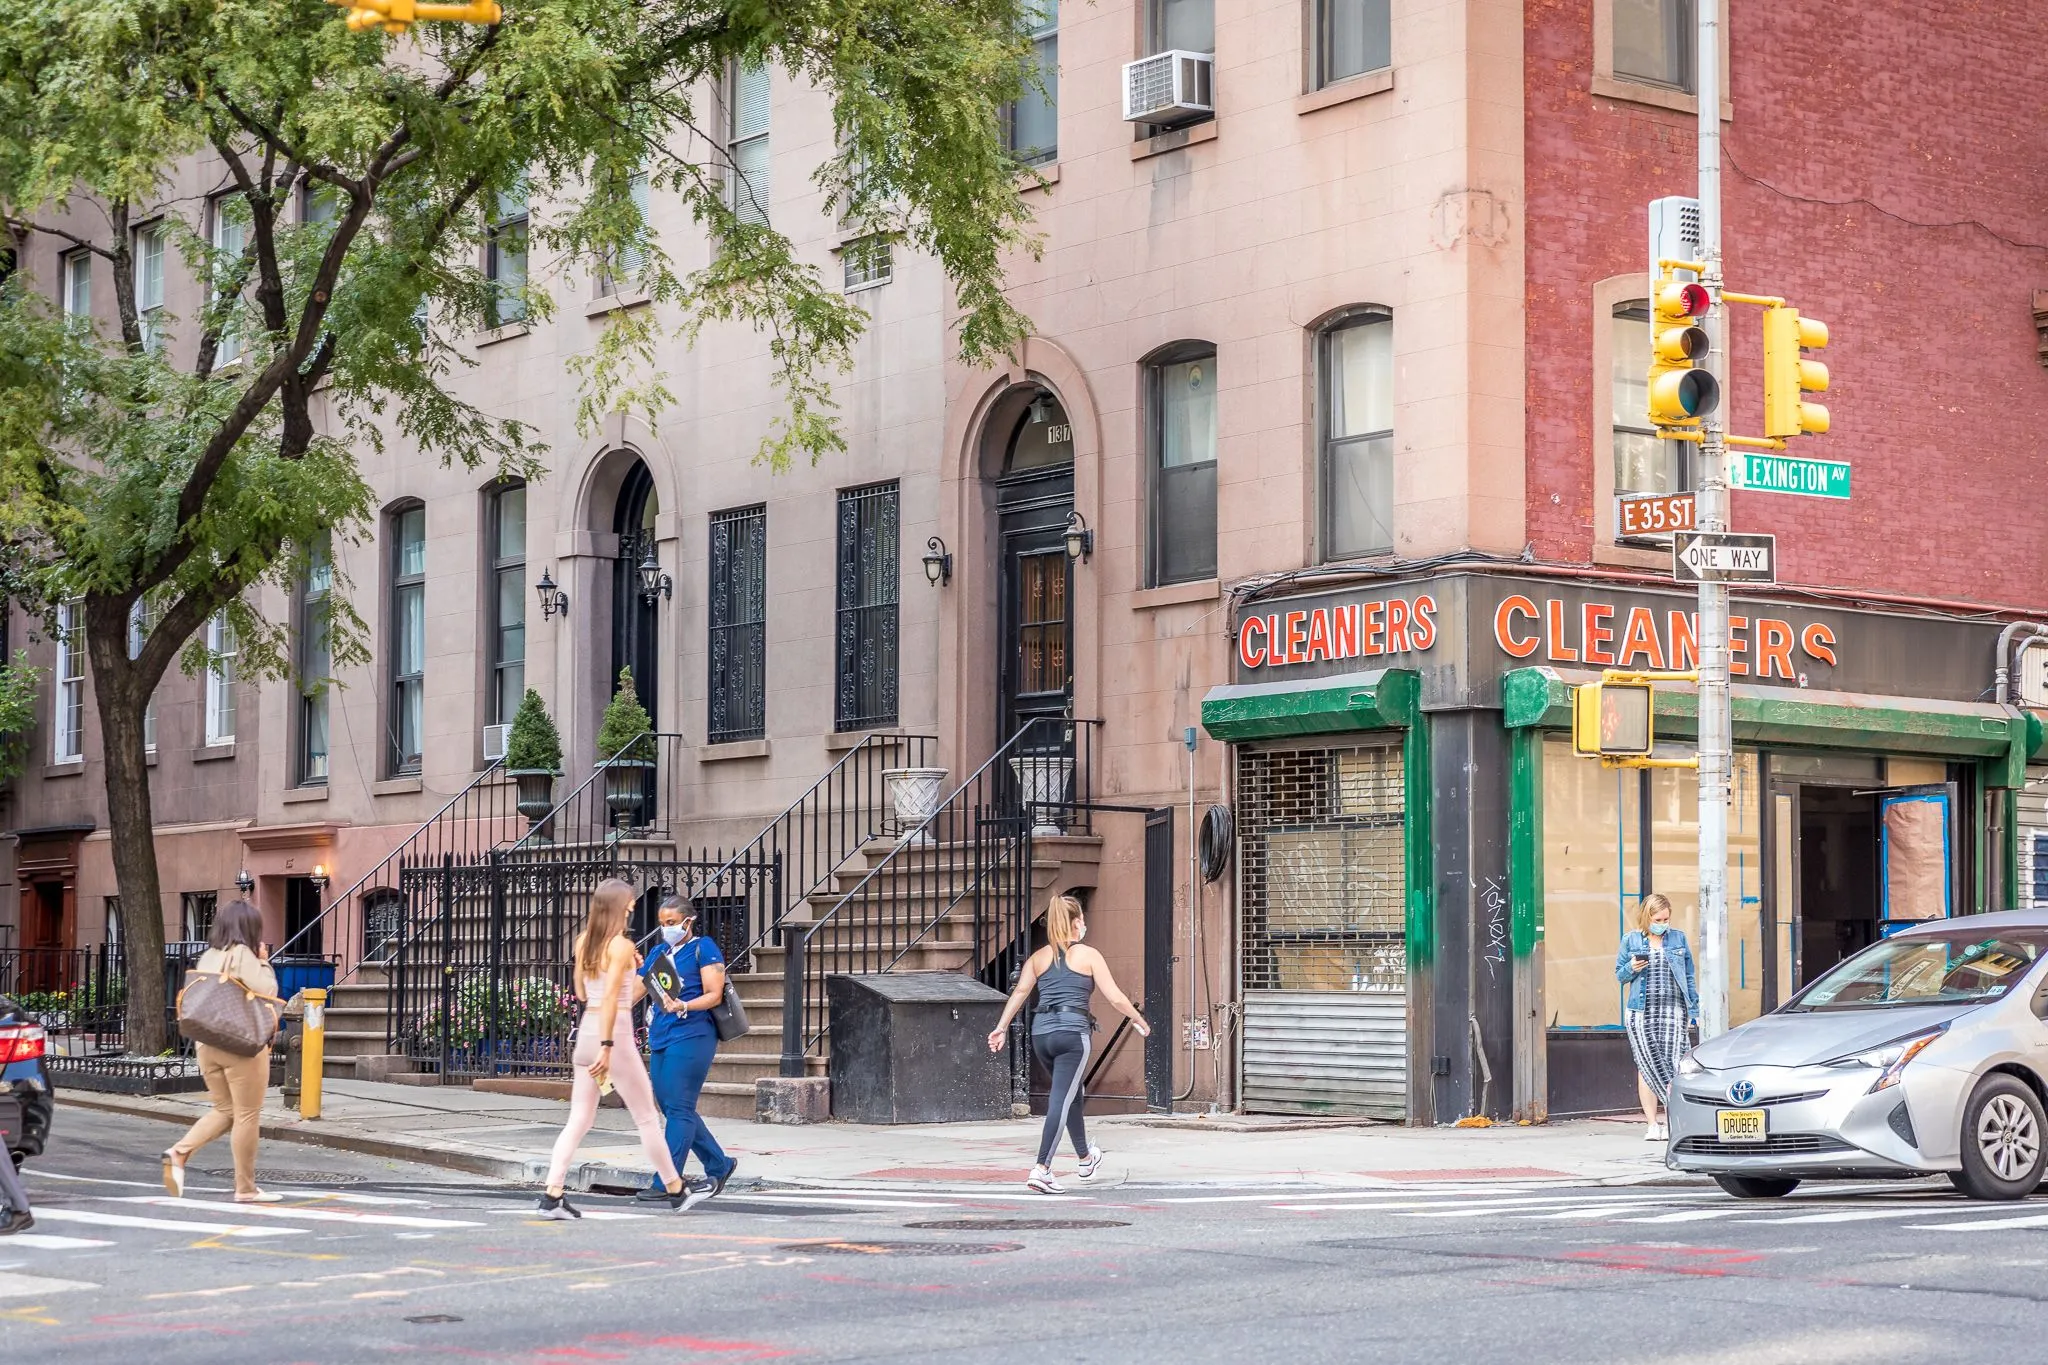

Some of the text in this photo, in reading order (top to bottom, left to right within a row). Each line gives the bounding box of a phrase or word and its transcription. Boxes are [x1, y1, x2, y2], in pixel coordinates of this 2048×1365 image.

[1047, 424, 1071, 444] 137
[1743, 457, 1847, 491] LEXINGTON AV
[1623, 498, 1693, 531] E 35 ST
[1690, 547, 1761, 568] ONE WAY
[1239, 594, 1437, 669] CLEANERS
[1494, 595, 1837, 680] CLEANERS
[1724, 1117, 1759, 1133] DRUBER
